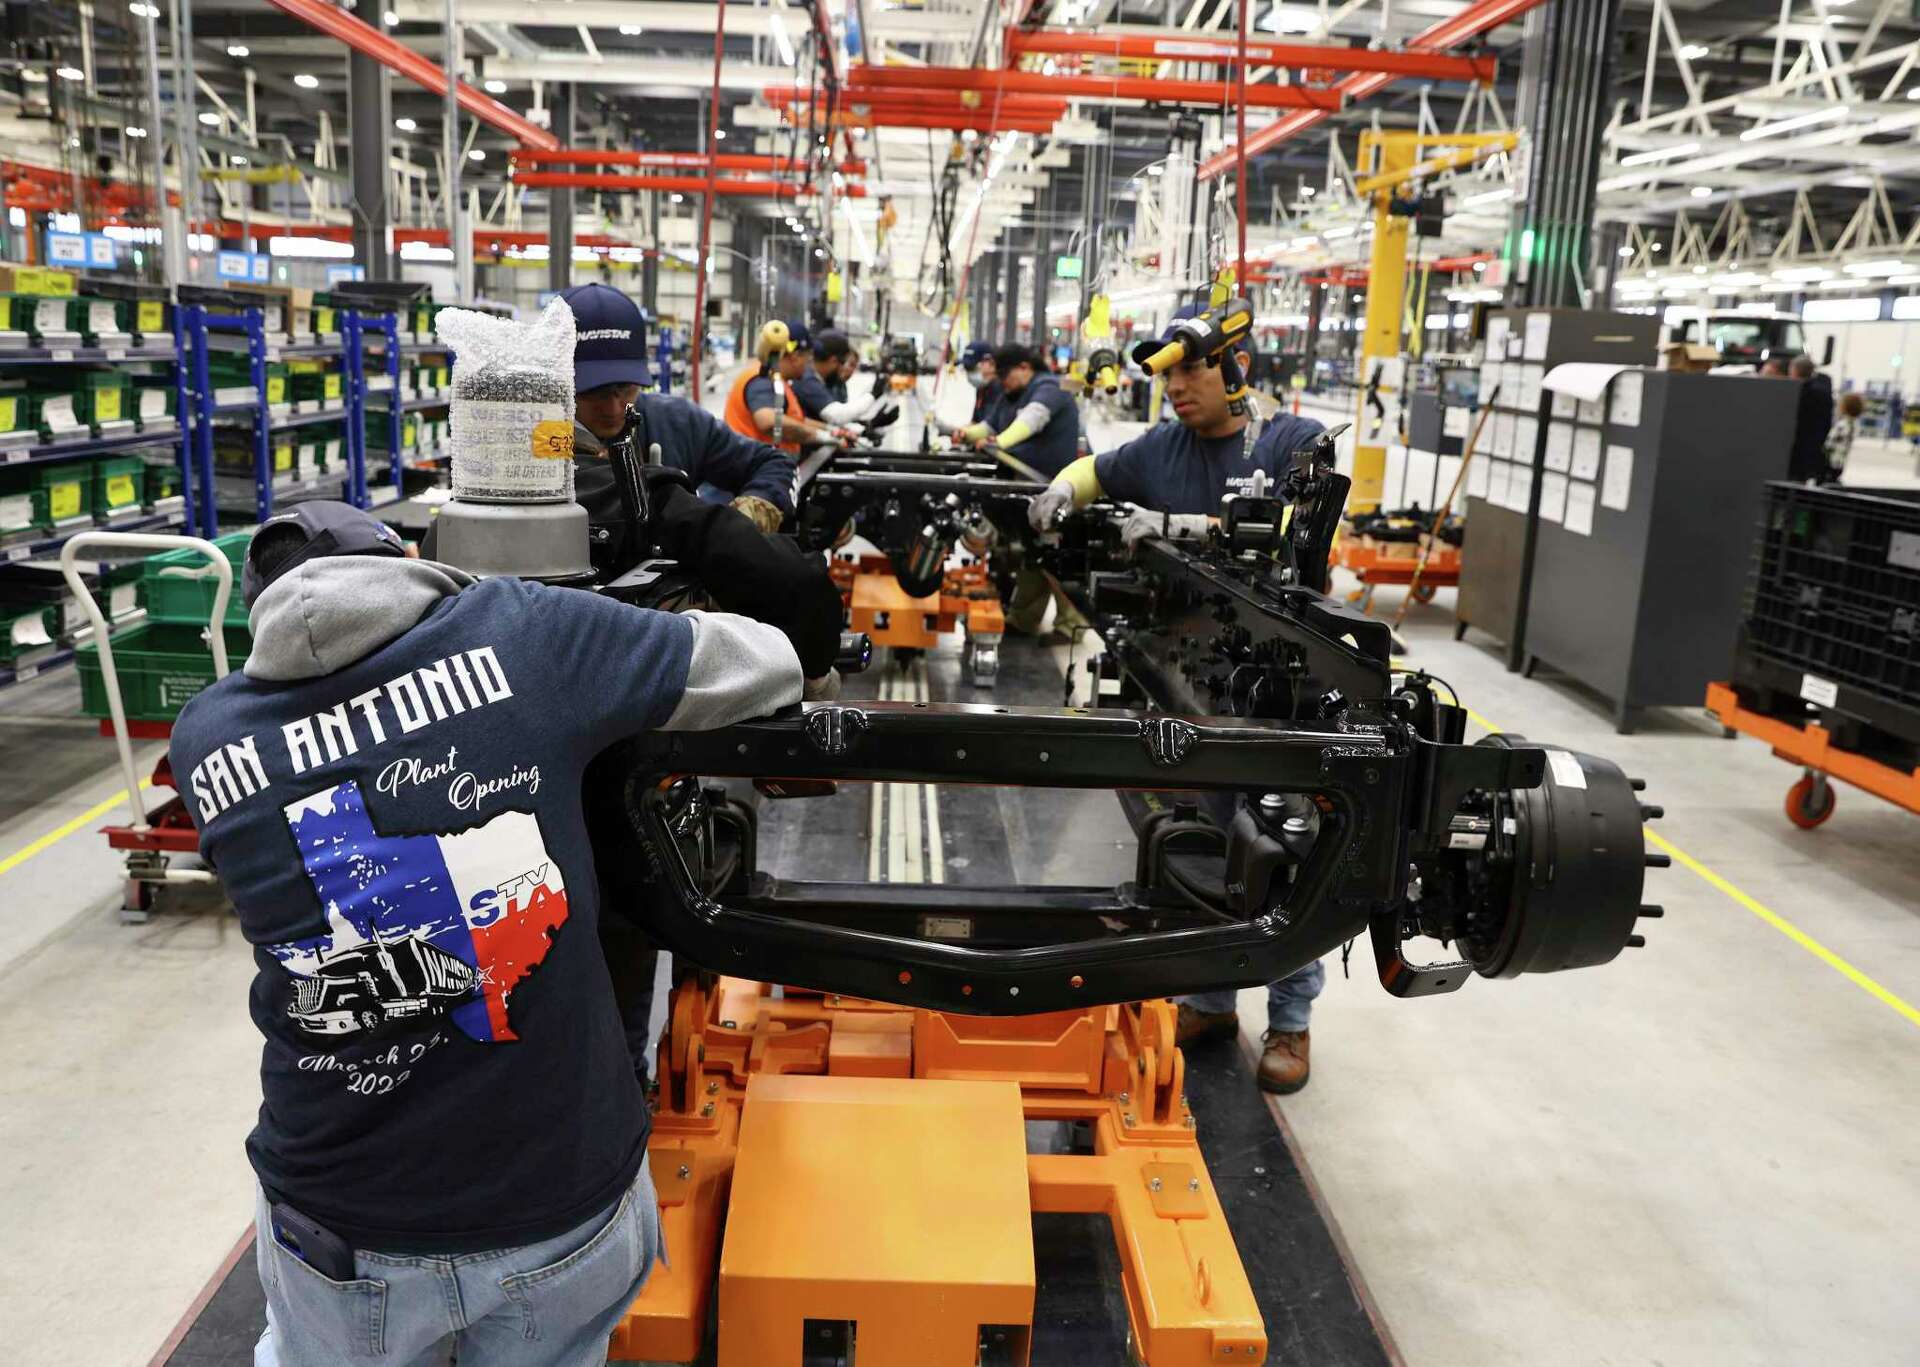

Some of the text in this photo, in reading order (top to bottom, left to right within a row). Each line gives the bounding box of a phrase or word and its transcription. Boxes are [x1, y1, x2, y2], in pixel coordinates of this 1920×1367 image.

[190, 645, 514, 825] SAN ANTONIO
[376, 746, 459, 798] Plant
[448, 765, 542, 811] Opening
